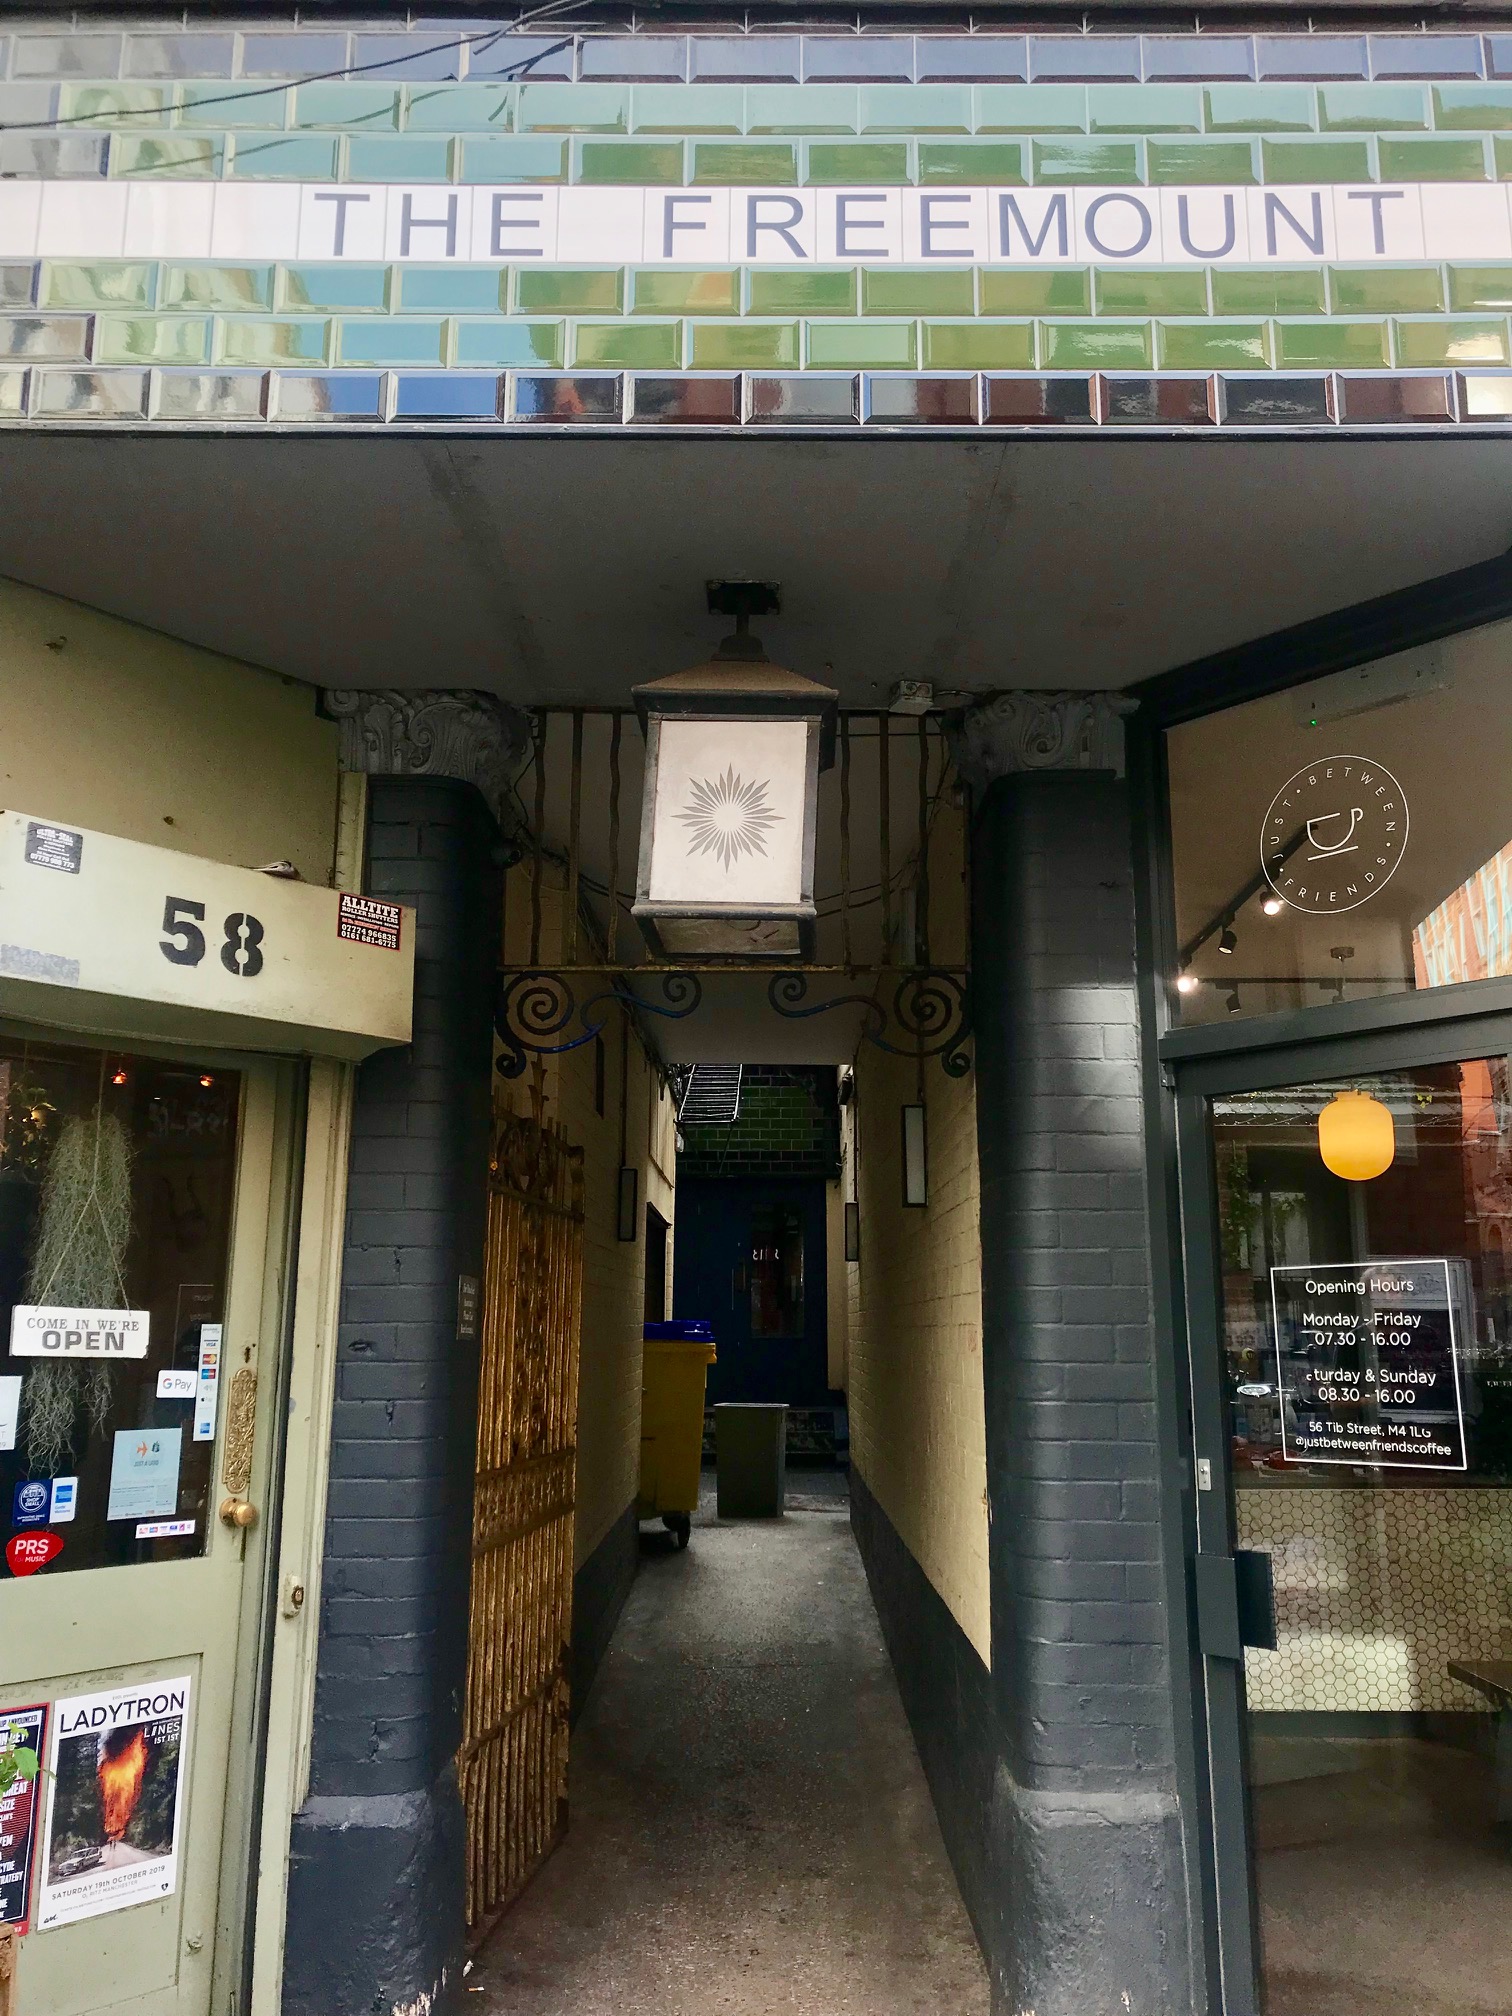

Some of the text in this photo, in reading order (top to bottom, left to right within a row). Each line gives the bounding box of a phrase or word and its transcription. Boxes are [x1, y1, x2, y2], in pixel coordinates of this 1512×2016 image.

[315, 191, 1404, 259] THE FREEMOUNT
[1270, 767, 1396, 902] JUST BETWEEN FRIENDS
[341, 906, 398, 924] ROLLER SHUTTERS
[342, 896, 399, 918] ALLTITE
[159, 896, 265, 977] 58
[341, 930, 397, 948] 0161 681-6775
[342, 924, 366, 935] 07774
[368, 930, 397, 942] 966835
[1305, 1279, 1414, 1296] Opening Hours
[26, 1318, 140, 1332] COME IN WE'RE
[1303, 1313, 1360, 1329] Monday
[1374, 1312, 1422, 1328] Friday
[42, 1330, 125, 1351] OPEN
[1314, 1332, 1356, 1346] 07.30
[1370, 1332, 1411, 1346] 16.00
[162, 1378, 192, 1392] G Pay
[1365, 1369, 1376, 1382] &
[1380, 1369, 1436, 1386] Sunday
[1318, 1388, 1360, 1402] 08.30
[1375, 1390, 1416, 1404] 16.00
[1308, 1422, 1322, 1433] 56
[1326, 1422, 1344, 1434] Tib
[1346, 1423, 1385, 1437] Street,
[1388, 1426, 1406, 1437] M4
[1295, 1436, 1452, 1456] @justbetweenfriendscoffee
[14, 1539, 49, 1555] PRS
[60, 1690, 185, 1733] LADYTRON
[154, 1733, 180, 1744] IST IST
[52, 1884, 92, 1900] SATURDAY
[95, 1880, 110, 1889] 19th
[112, 1870, 147, 1884] OCTOBER
[149, 1865, 166, 1876] 2019
[102, 1880, 138, 1893] MANCHESTER
